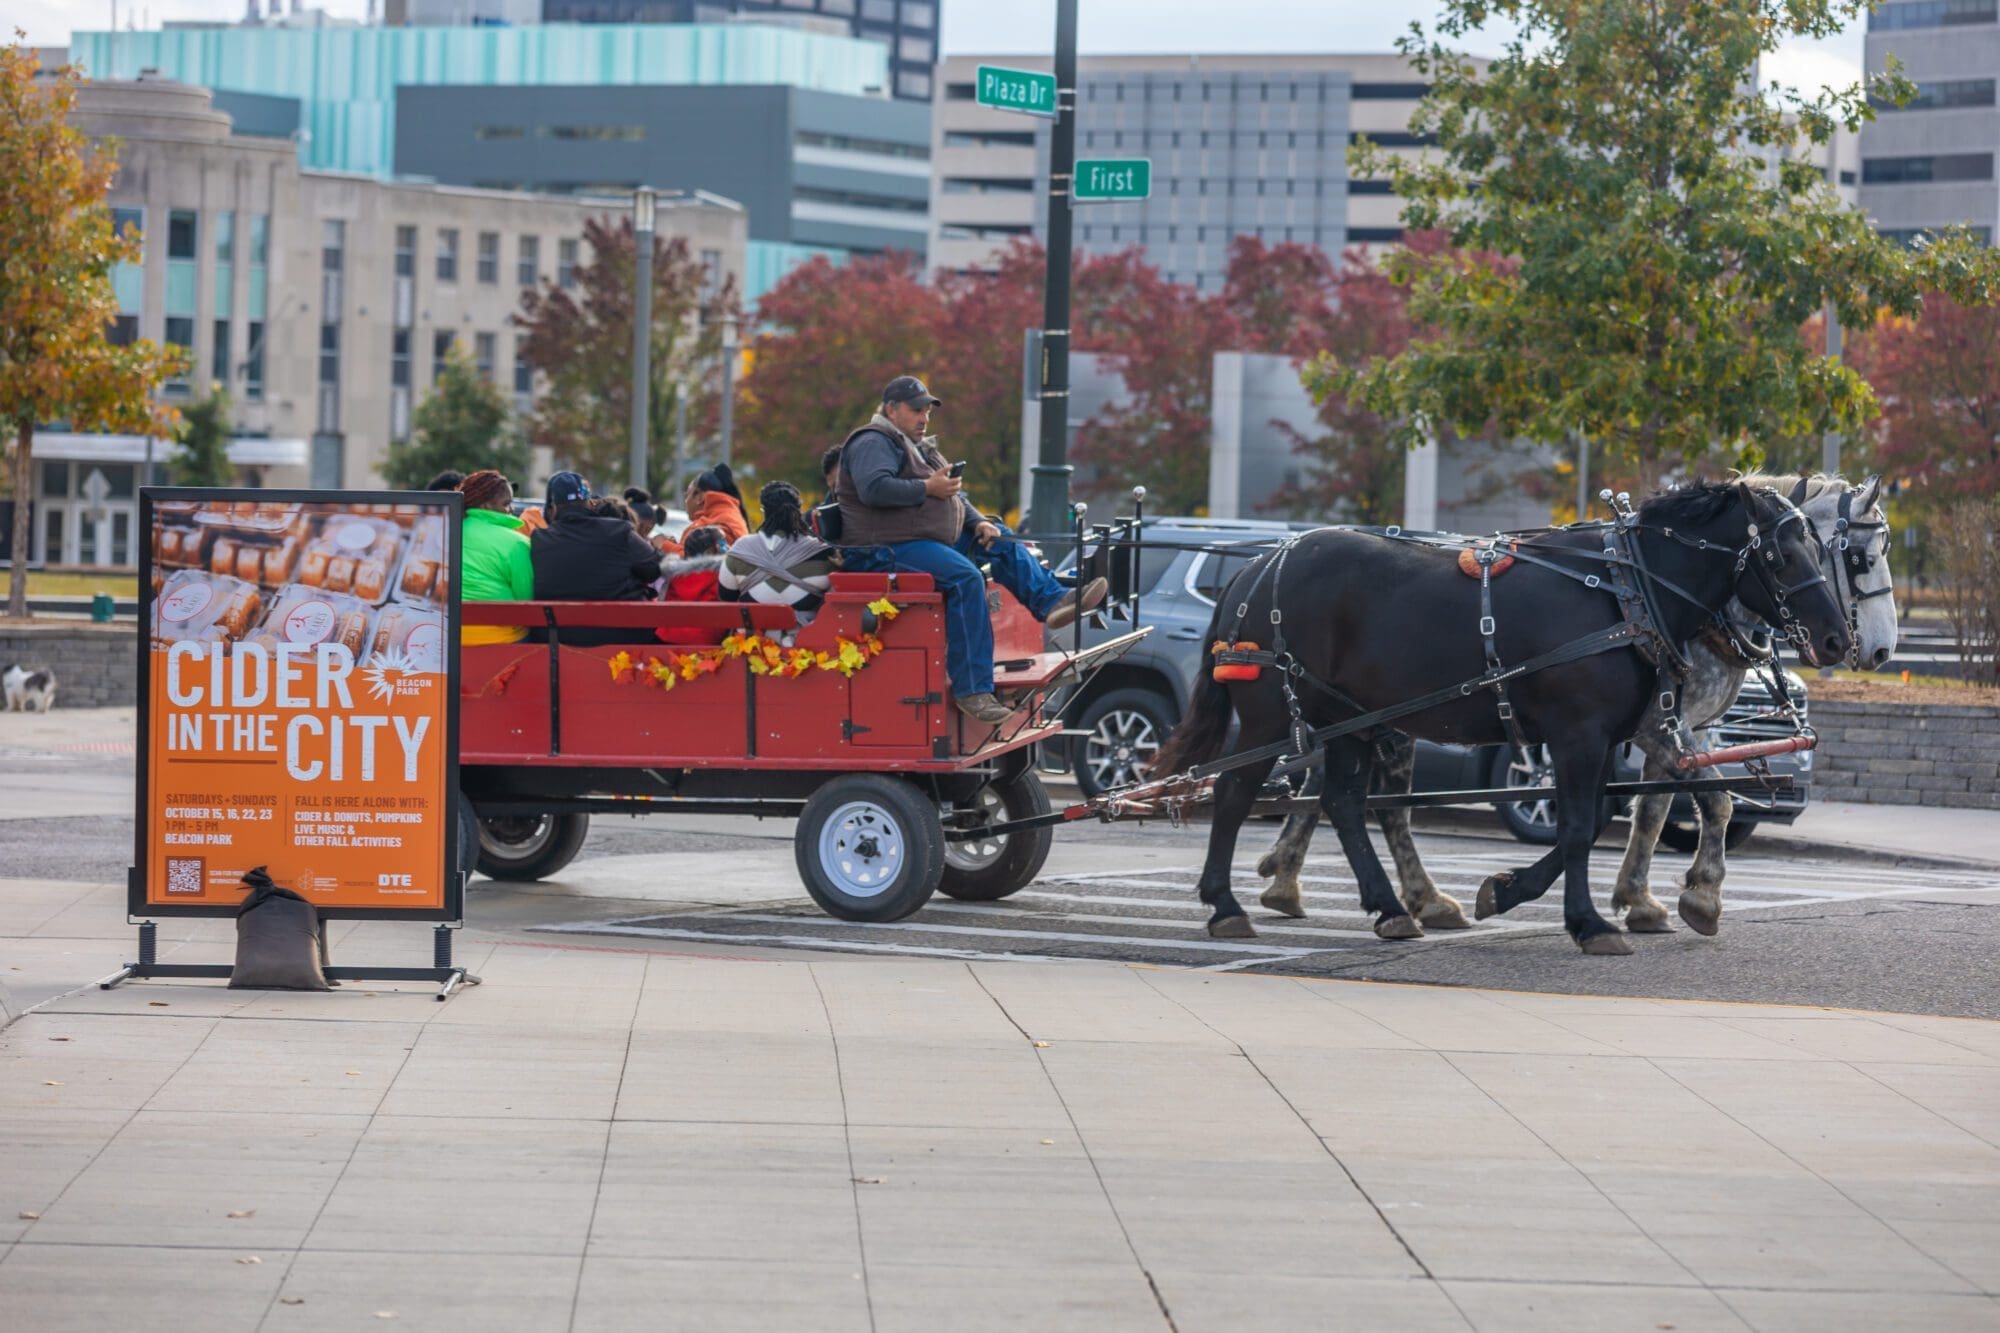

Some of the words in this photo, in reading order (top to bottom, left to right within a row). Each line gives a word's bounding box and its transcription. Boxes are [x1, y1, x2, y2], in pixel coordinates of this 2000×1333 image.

[986, 74, 1026, 102] Plaza
[1030, 80, 1046, 104] Dr
[1091, 167, 1133, 191] First
[167, 640, 355, 709] CIDER
[396, 679, 432, 687] BEACON
[396, 687, 420, 695] PARK
[168, 713, 202, 750] IN
[209, 714, 278, 751] THE
[286, 714, 431, 782] CITY
[166, 793, 223, 805] SATURDAYS
[232, 794, 277, 806] SUNDAYS
[295, 795, 319, 806] FALL
[322, 796, 331, 807] IS
[335, 796, 360, 807] HERE
[363, 797, 396, 808] ALONG
[399, 797, 429, 808] WITH:
[165, 807, 209, 818] OCTOBER
[212, 808, 224, 820] 15,
[242, 808, 257, 820] 22,
[259, 808, 273, 820] 23
[295, 811, 322, 822] CIDER
[323, 812, 331, 822] &
[334, 812, 373, 823] DONUTS,
[375, 812, 423, 823] PUMPKINS
[172, 821, 186, 831] PM
[205, 821, 219, 831] PM
[294, 824, 316, 834] LIVE
[317, 824, 346, 835] MUSIC
[347, 825, 355, 835] &
[165, 833, 204, 844] BEACON
[206, 834, 233, 845] PARK
[294, 835, 325, 846] OTHER
[326, 836, 349, 847] FALL
[351, 836, 402, 848] ACTIVITIES
[378, 873, 412, 887] DTE
